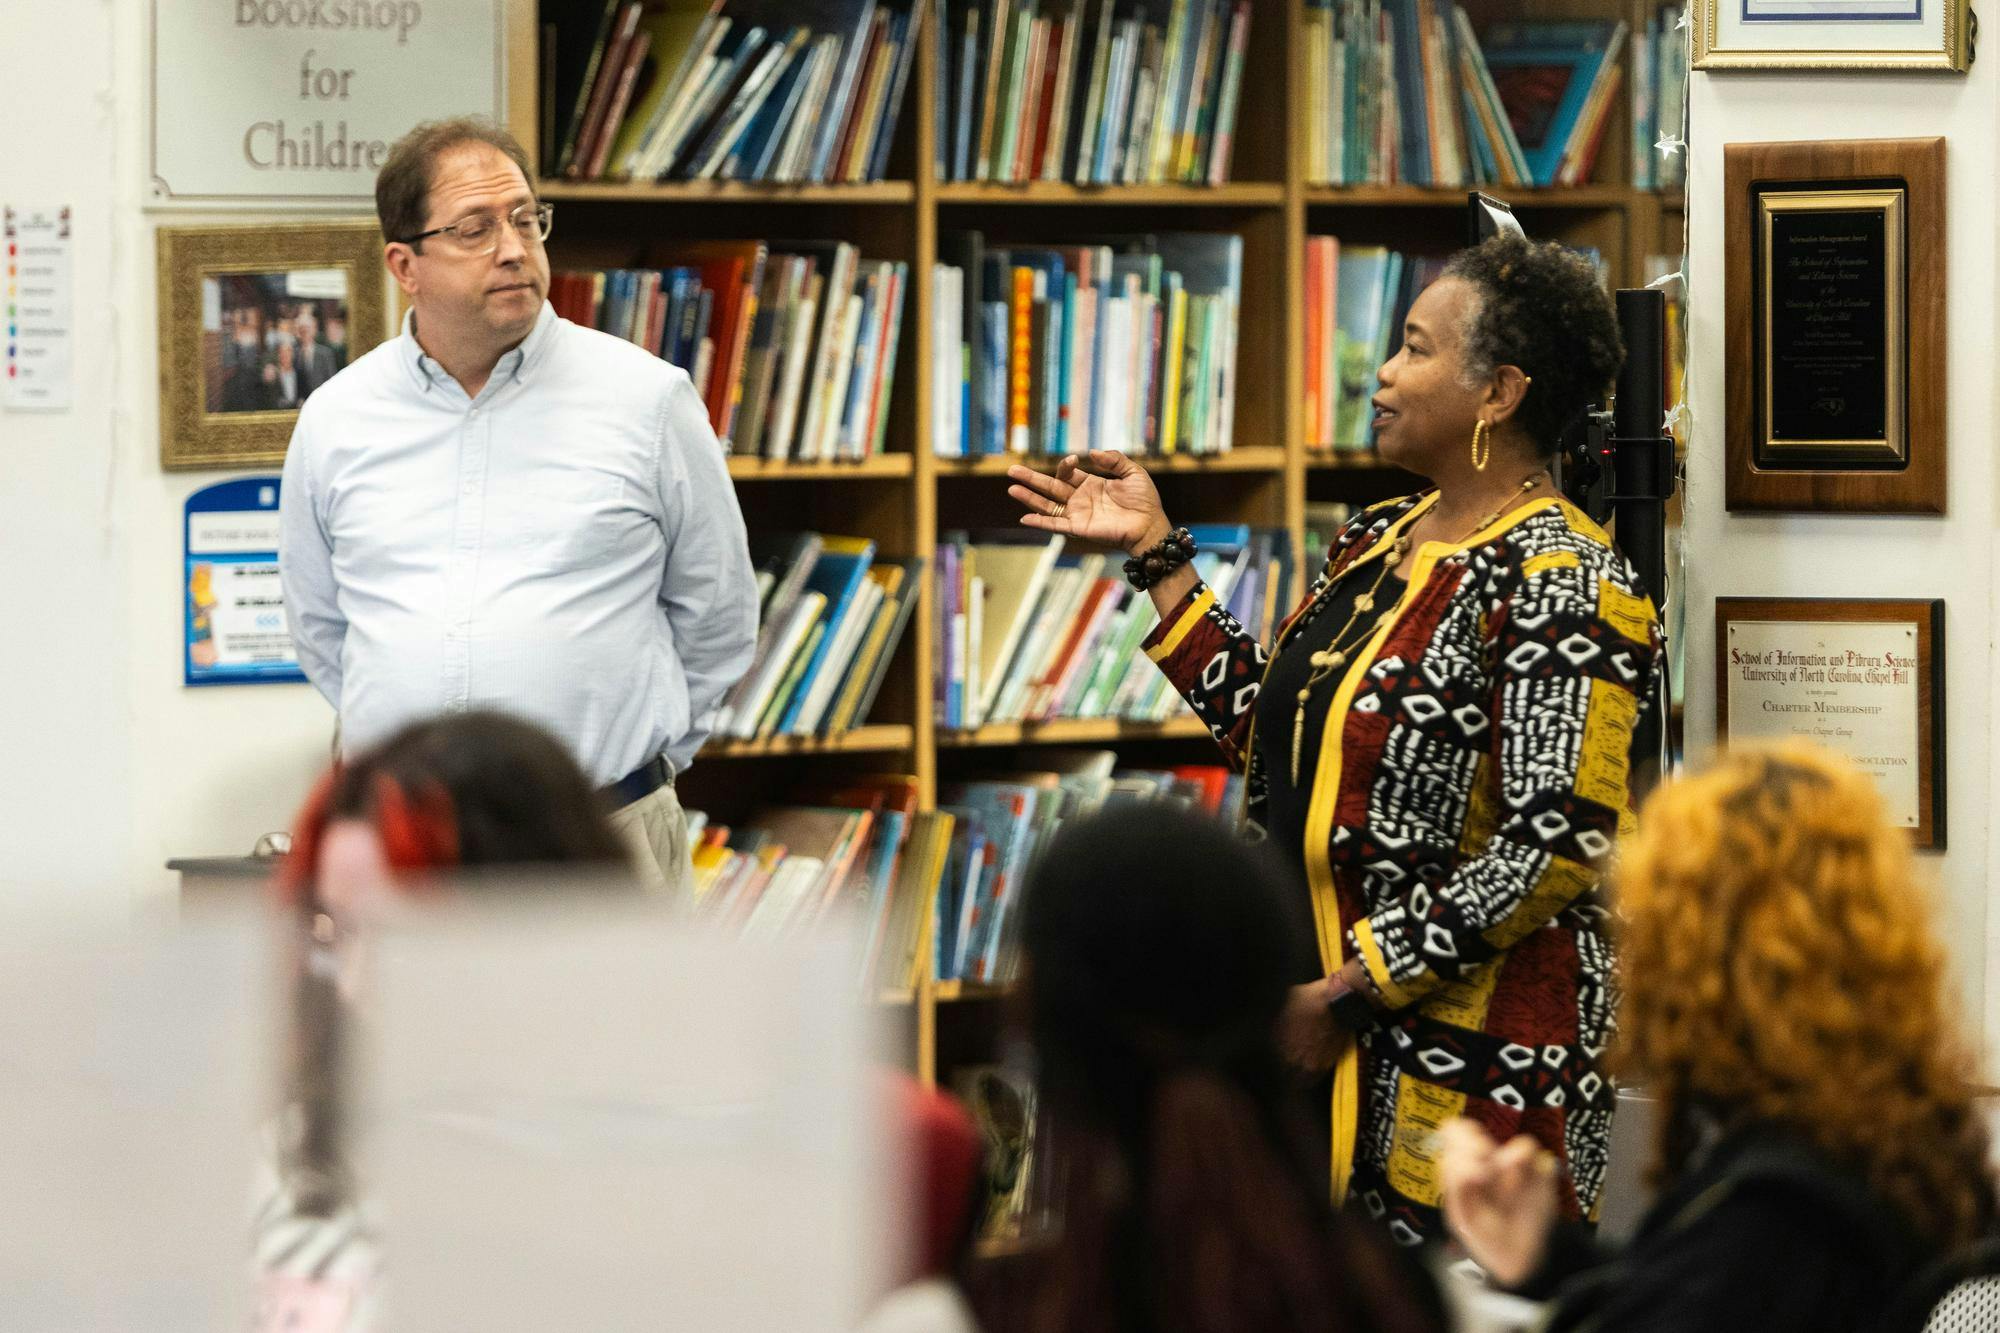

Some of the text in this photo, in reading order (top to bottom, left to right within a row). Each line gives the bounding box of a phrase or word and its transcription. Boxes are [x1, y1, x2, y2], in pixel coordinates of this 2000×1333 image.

[300, 49, 356, 100] for
[243, 119, 388, 173] Childre
[1731, 648, 1916, 668] School of Information and Library Science
[1742, 666, 1909, 687] University of North Carolina Chapel Hill
[1762, 700, 1883, 715] CHARTER MEMBERSHIP
